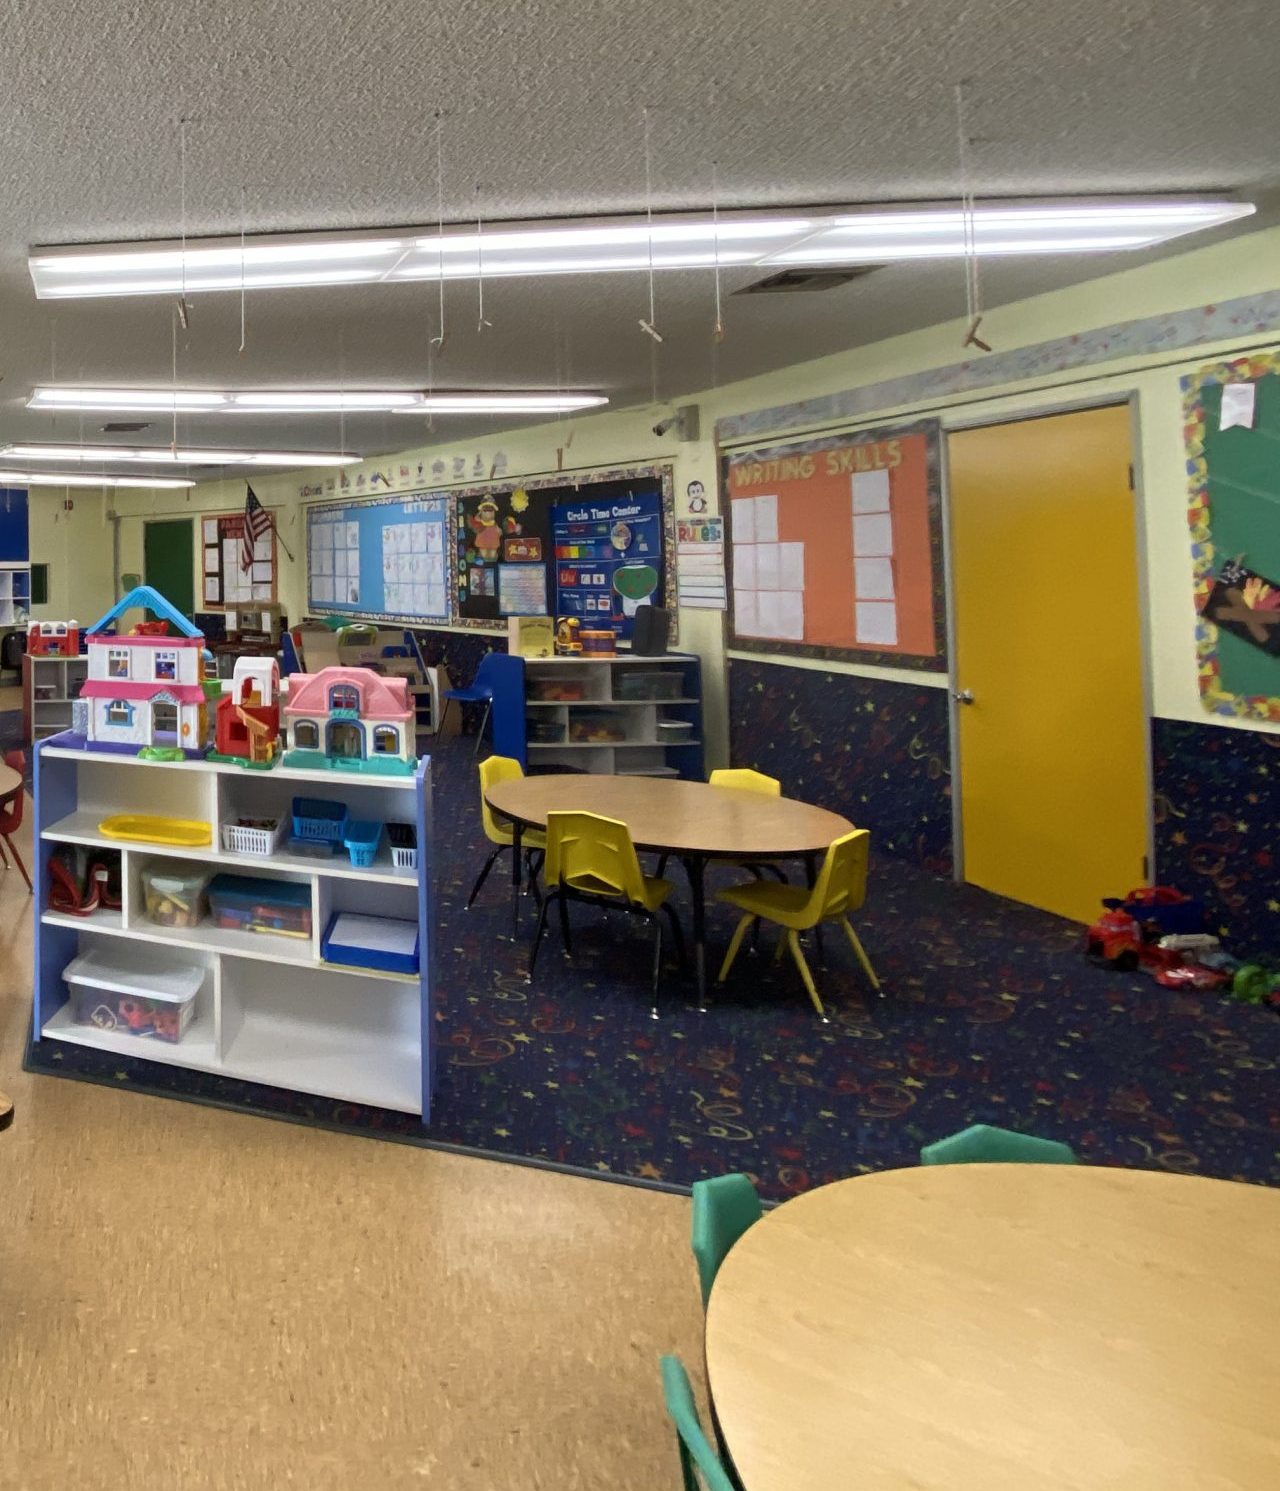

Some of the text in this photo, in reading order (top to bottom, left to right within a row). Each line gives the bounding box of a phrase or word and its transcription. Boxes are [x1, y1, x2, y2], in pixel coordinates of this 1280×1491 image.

[736, 441, 901, 487] WRITING SKILLS
[567, 506, 641, 521] Circle Time Center
